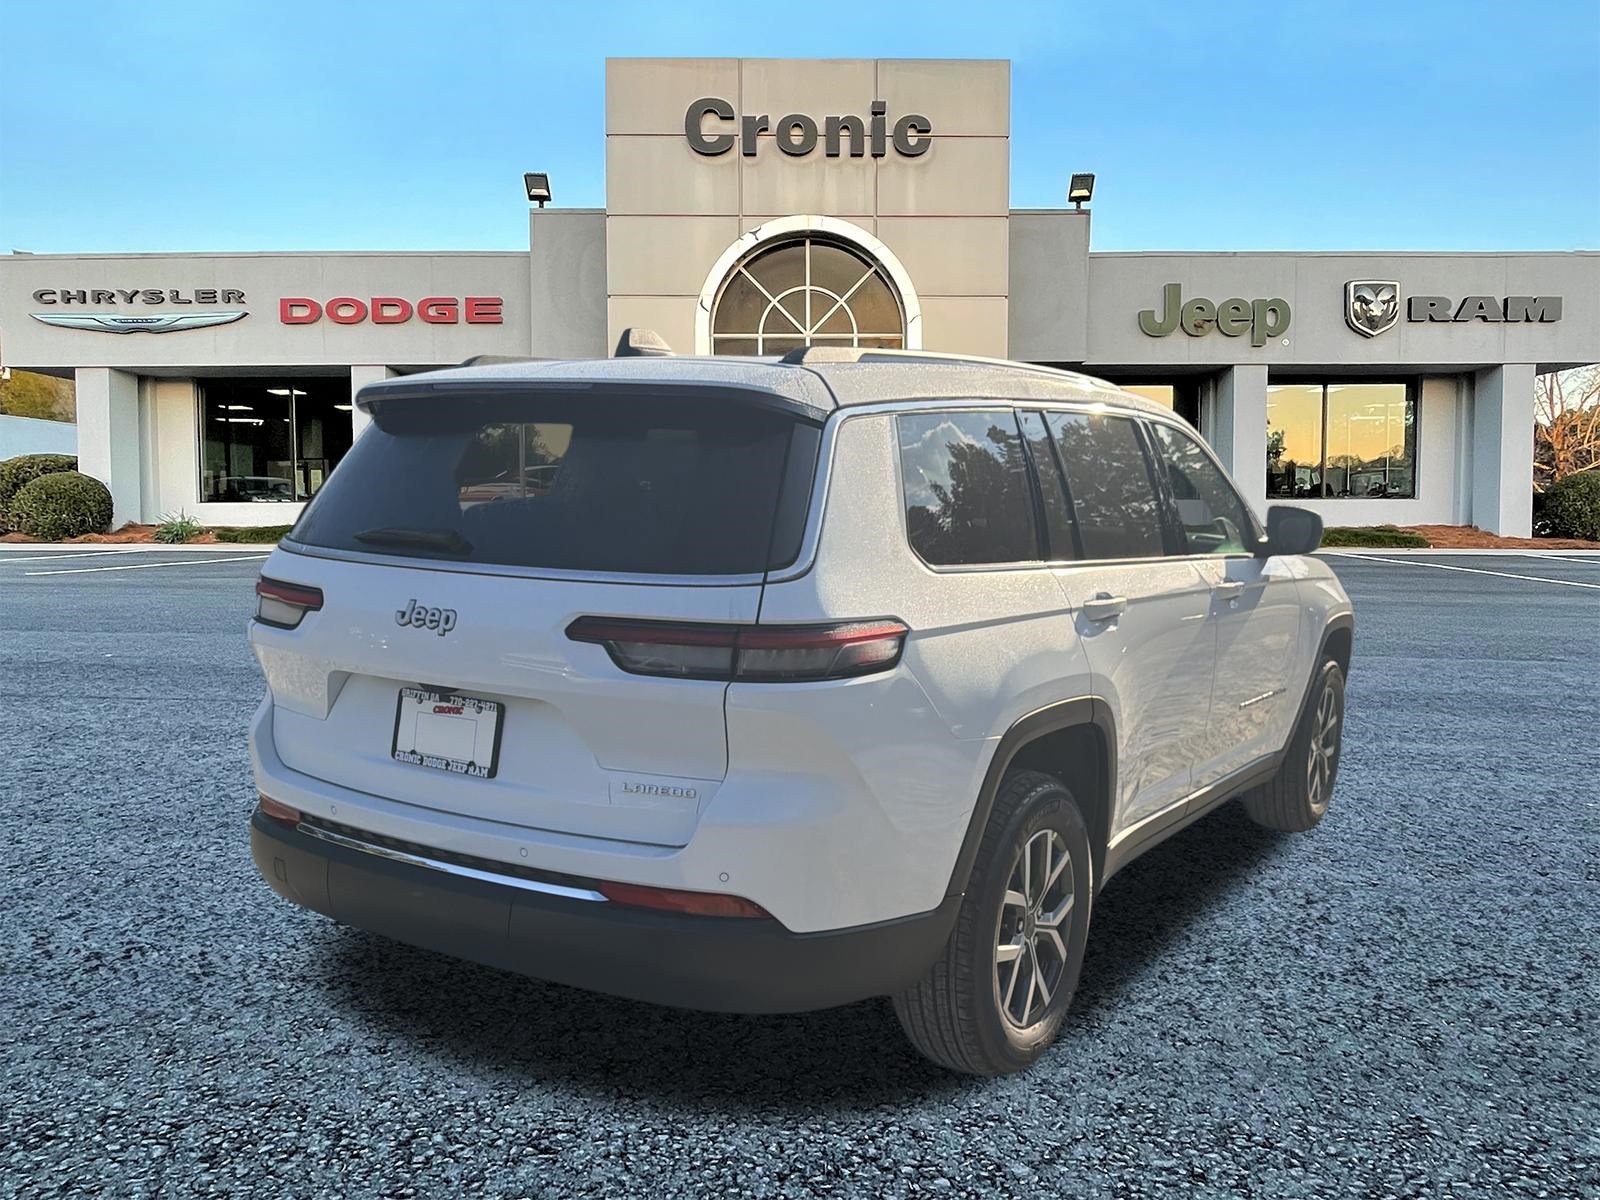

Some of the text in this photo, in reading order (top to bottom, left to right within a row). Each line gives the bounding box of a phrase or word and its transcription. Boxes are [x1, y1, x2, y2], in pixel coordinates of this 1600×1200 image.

[685, 97, 932, 157] Cronic
[32, 288, 247, 305] CHRYSLER
[279, 296, 503, 325] DODGE
[1407, 296, 1563, 323] RAM
[1137, 282, 1292, 348] Jeep
[395, 598, 457, 636] Jeep
[395, 751, 489, 778] CRONIC DODGE JEEP RAM
[622, 782, 697, 799] LAREDO
